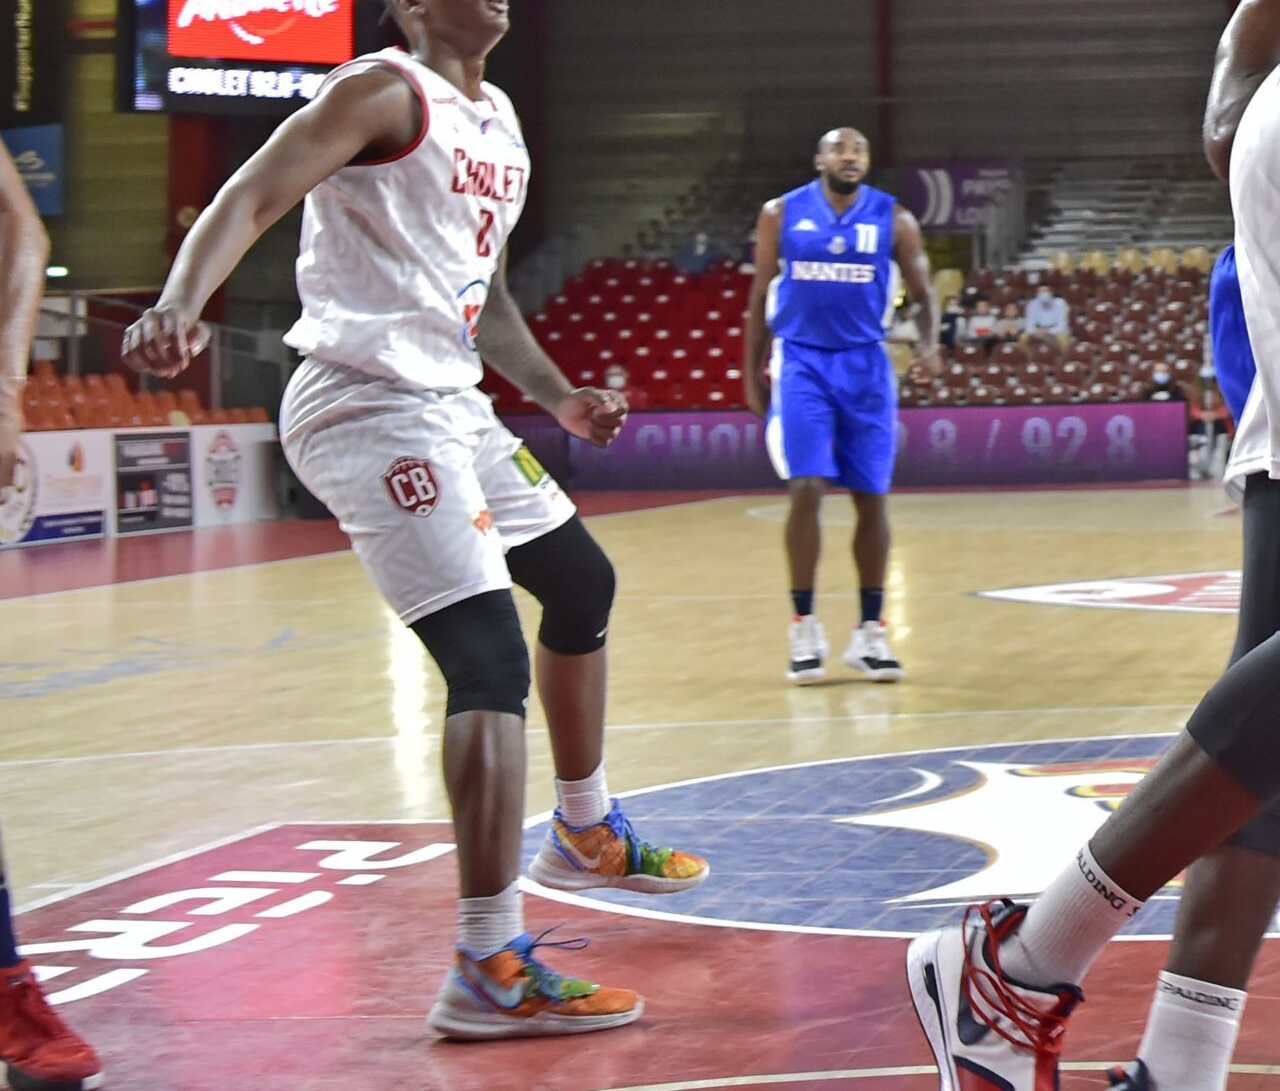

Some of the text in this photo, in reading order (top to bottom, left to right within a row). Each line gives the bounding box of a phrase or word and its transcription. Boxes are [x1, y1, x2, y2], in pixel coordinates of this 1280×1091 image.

[855, 223, 879, 253] 11
[790, 261, 876, 284] NANTES
[390, 466, 438, 508] CB
